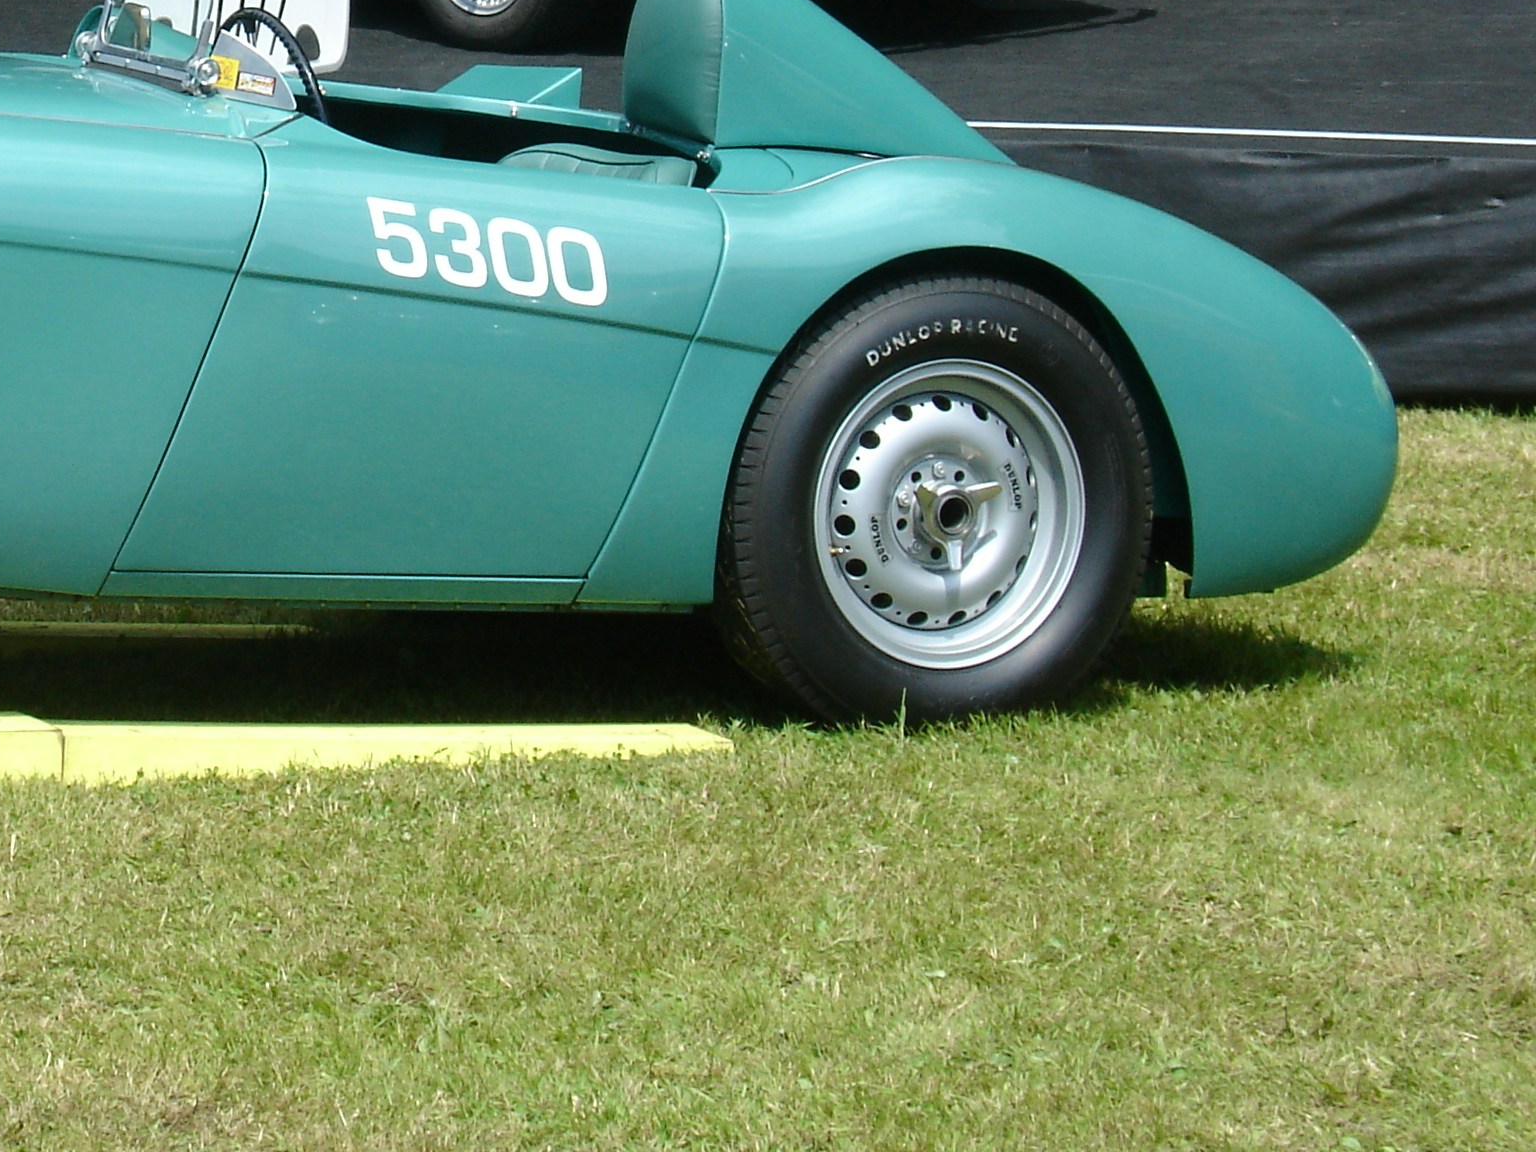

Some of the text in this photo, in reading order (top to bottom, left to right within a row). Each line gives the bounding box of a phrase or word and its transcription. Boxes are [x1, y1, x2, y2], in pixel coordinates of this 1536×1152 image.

[366, 196, 608, 306] 5300
[1003, 462, 1023, 510] DUNLOP
[870, 516, 890, 563] DUNLOP
